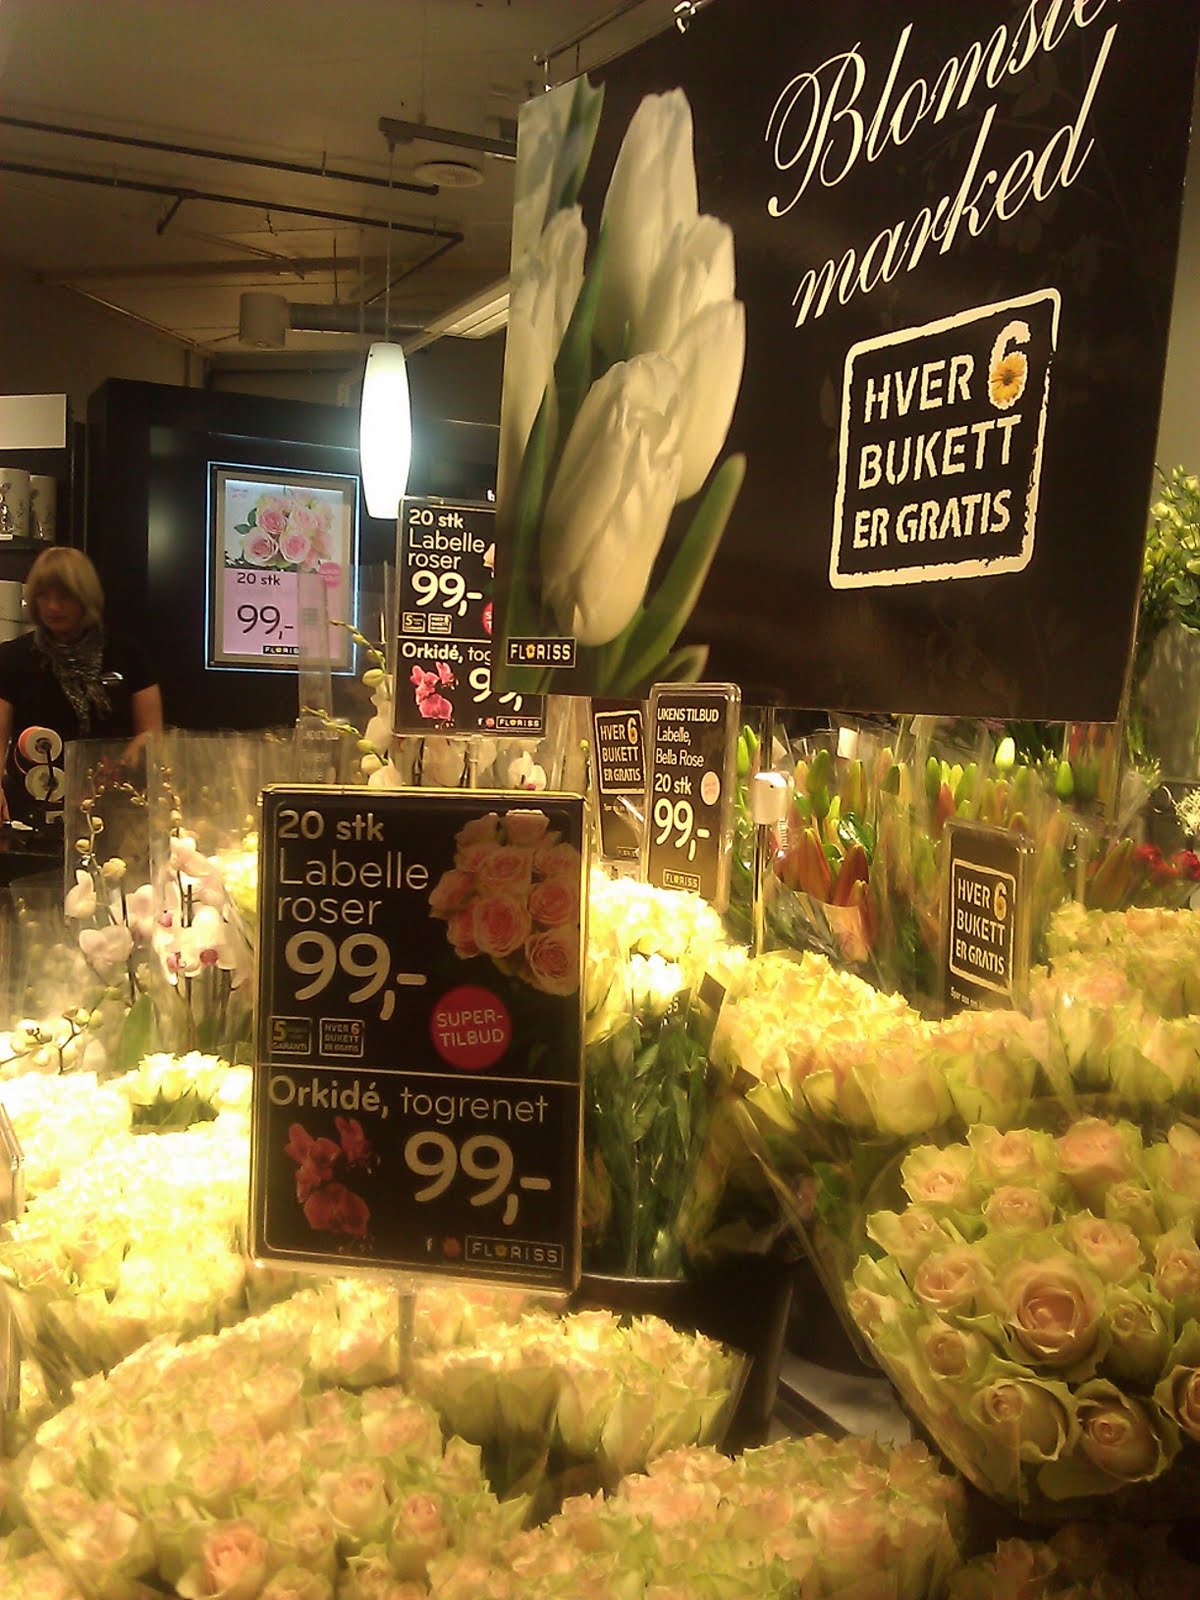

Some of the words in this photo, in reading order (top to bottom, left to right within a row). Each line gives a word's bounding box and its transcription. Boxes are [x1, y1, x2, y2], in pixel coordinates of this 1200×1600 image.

[792, 23, 1118, 328] marked
[863, 353, 975, 424] HVER
[987, 319, 1031, 411] 6
[857, 413, 1022, 490] BUKETT
[408, 508, 434, 526] 20
[437, 512, 464, 529] stk
[852, 505, 889, 550] ER
[895, 488, 1012, 544] GRATIS
[408, 527, 485, 553] Labelle
[407, 551, 462, 570] roser
[237, 572, 257, 585] 20
[260, 573, 281, 586] stk
[411, 569, 483, 617] 99,-
[236, 604, 294, 640] 99,-
[401, 641, 464, 664] Orkidé,
[509, 643, 571, 661] FLORISS
[657, 707, 686, 721] UKENS
[686, 707, 719, 723] TILBUD
[600, 724, 626, 740] HVER
[627, 716, 638, 745] 6
[656, 725, 691, 746] Labelle,
[602, 746, 639, 762] BUKETT
[655, 747, 678, 766] Bella
[679, 748, 705, 768] Rose
[603, 767, 613, 781] ER
[613, 767, 642, 782] GRATIS
[654, 772, 672, 793] 20
[673, 775, 692, 795] stk
[277, 809, 325, 840] 20
[336, 812, 385, 842] stk
[654, 797, 710, 862] 99,-
[278, 847, 430, 891] Labelle
[277, 895, 383, 926] roser
[957, 877, 991, 910] HVER
[993, 881, 1007, 921] 6
[956, 907, 1006, 947] BUKETT
[955, 938, 967, 960] ER
[967, 945, 1005, 976] GRATIS
[284, 929, 428, 1022] 99,-
[350, 1022, 360, 1035] 6
[436, 1008, 503, 1028] SUPER-
[439, 1028, 504, 1048] TILBUD
[267, 1074, 390, 1119] Orkidé,
[400, 1087, 549, 1125] togrenet
[404, 1130, 551, 1226] 99,-
[471, 1241, 558, 1264] FLORISS
